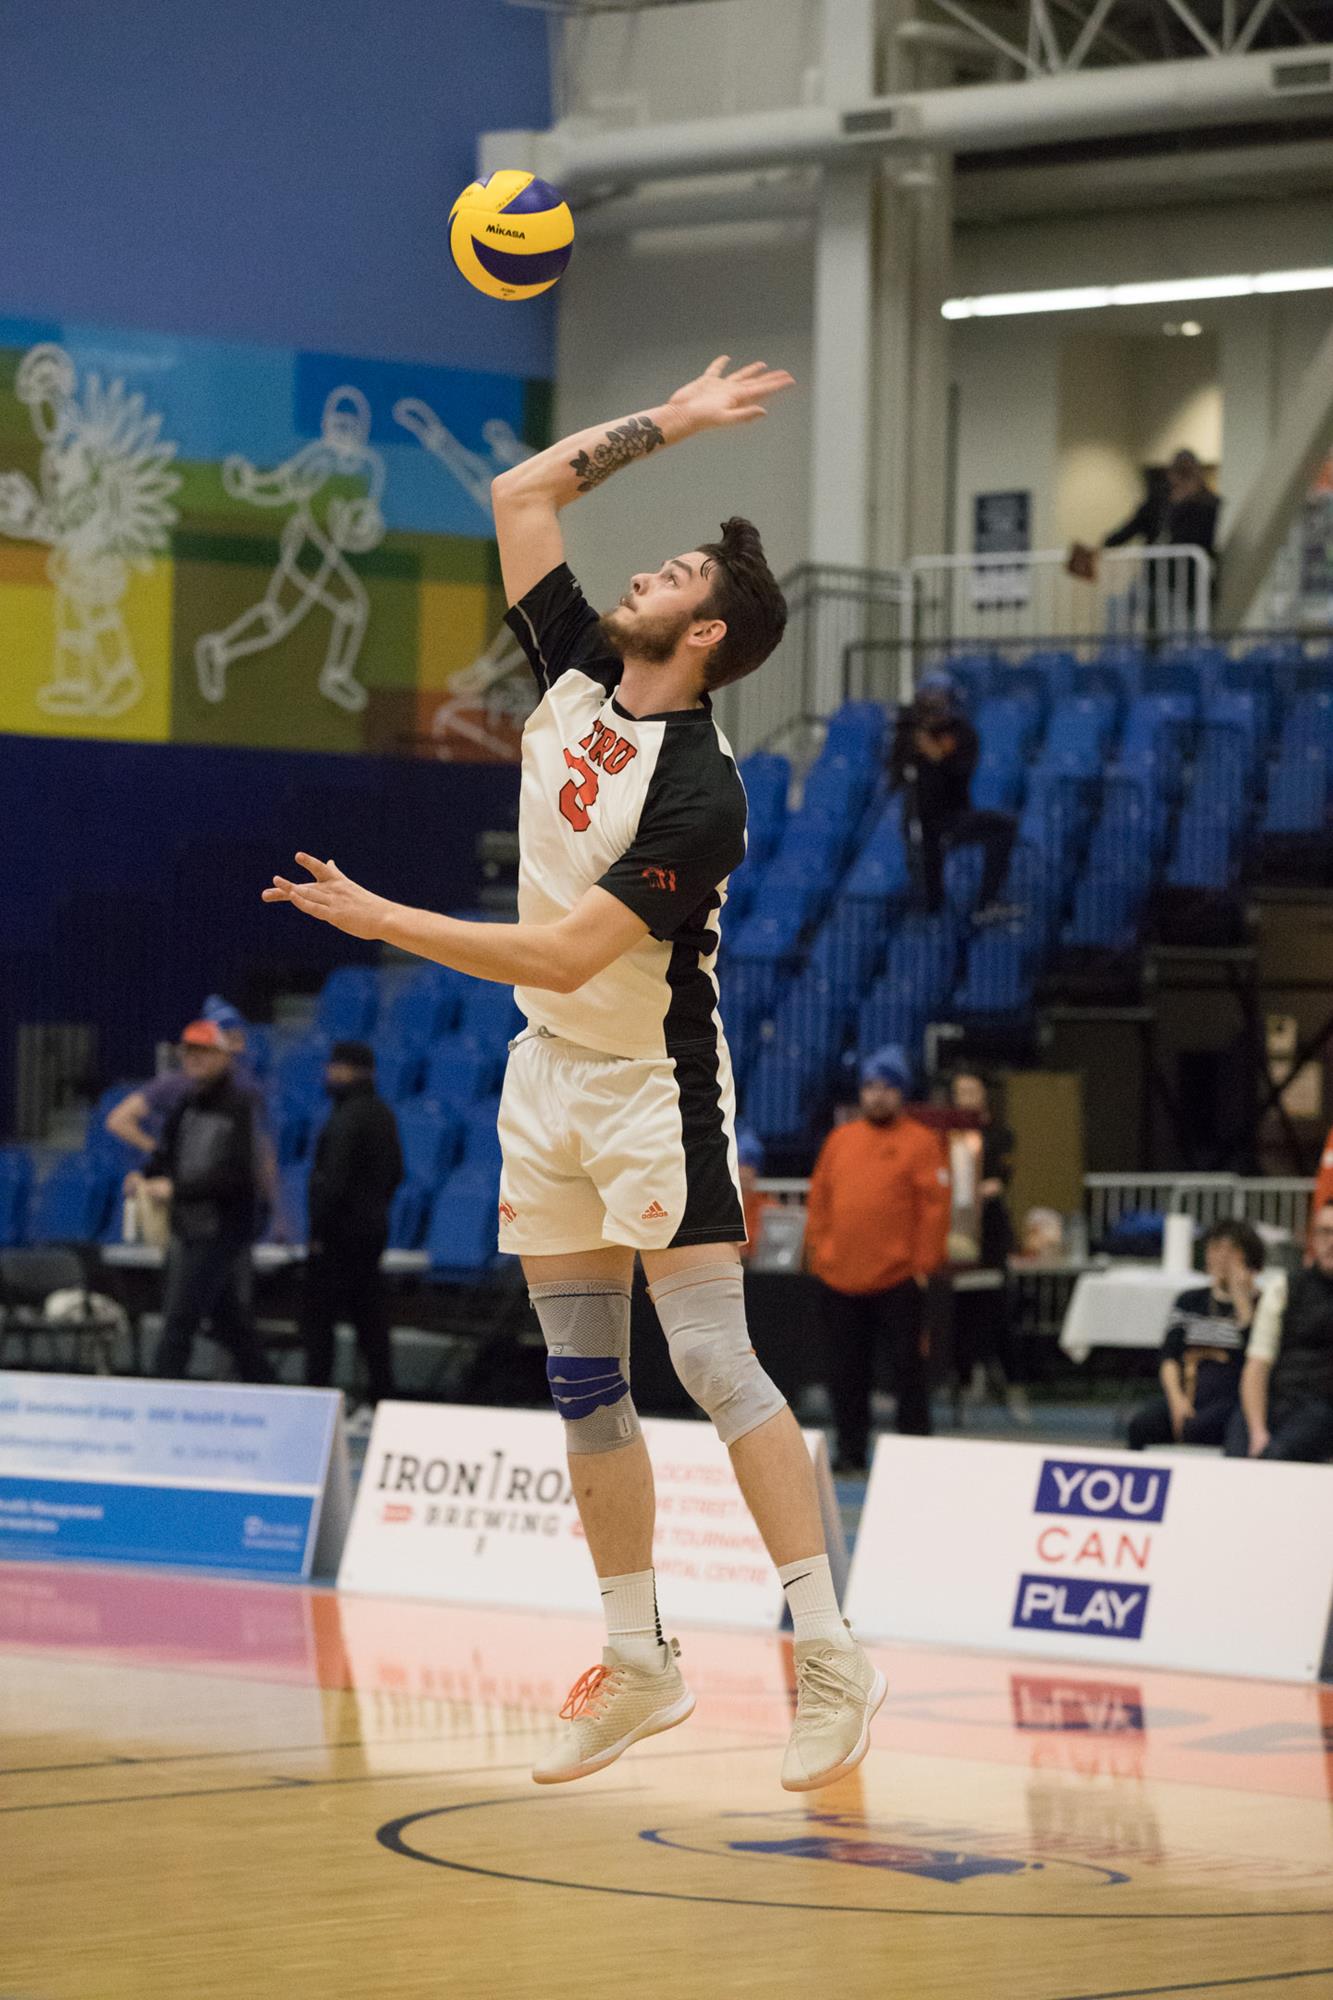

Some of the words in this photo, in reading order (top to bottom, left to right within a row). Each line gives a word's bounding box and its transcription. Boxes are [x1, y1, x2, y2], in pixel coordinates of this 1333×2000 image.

[641, 1210, 669, 1219] adidas
[376, 1453, 482, 1496] IRON
[506, 1466, 573, 1505] RO
[1051, 1467, 1160, 1515] YOU
[425, 1504, 559, 1537] BREWING
[1036, 1525, 1151, 1569] CAN
[1020, 1582, 1142, 1630] PLAY
